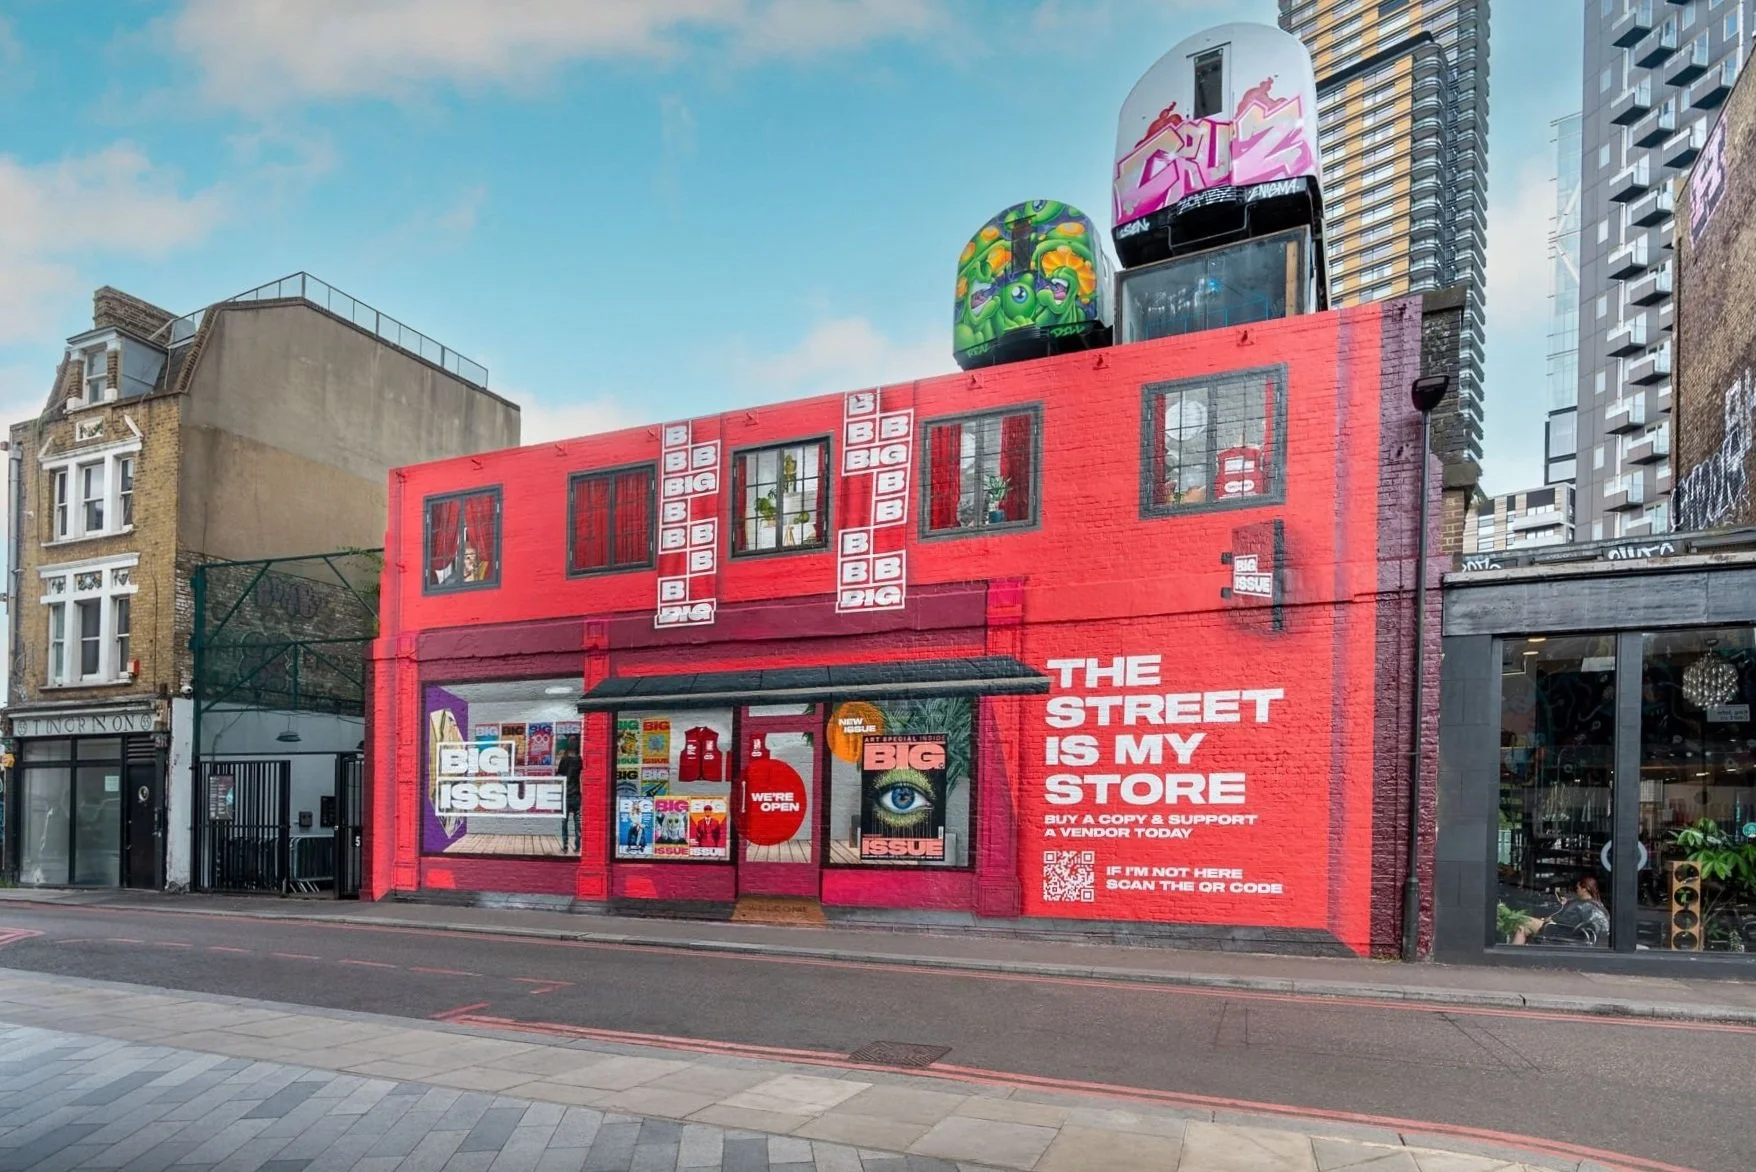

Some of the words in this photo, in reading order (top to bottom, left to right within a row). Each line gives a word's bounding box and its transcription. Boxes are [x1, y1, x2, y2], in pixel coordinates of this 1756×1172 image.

[665, 425, 688, 448] B
[846, 421, 874, 444] B
[881, 415, 909, 439] B
[665, 451, 687, 474] B
[693, 445, 717, 468] B
[847, 443, 908, 470] BIG
[664, 472, 717, 498] BIG
[878, 470, 905, 495] B
[664, 501, 687, 524] B
[876, 498, 902, 523] B
[662, 528, 686, 551] B
[691, 523, 714, 545] B
[843, 532, 869, 555] B
[691, 549, 714, 572] B
[843, 560, 868, 584] B
[874, 556, 901, 581] B
[1235, 559, 1256, 572] BIG
[661, 580, 685, 602] B
[1235, 576, 1270, 593] ISSUE
[841, 585, 902, 608] BIG
[1046, 654, 1162, 689] THE
[1045, 688, 1285, 729] STREET
[476, 726, 498, 736] BIG
[502, 726, 524, 735] BIG
[643, 721, 670, 731] BIG
[838, 718, 863, 727] NEW
[843, 724, 877, 733] ISSUE
[441, 746, 509, 774] BIG
[863, 743, 945, 771] BIG
[1045, 734, 1100, 767] IS
[1115, 732, 1208, 766] MY
[440, 783, 562, 810] ISSUE
[751, 792, 795, 802] WE'RE
[1044, 772, 1246, 806] STORE
[655, 799, 689, 812] BIG
[760, 802, 800, 812] OPEN
[1044, 814, 1079, 826] BUY
[1082, 814, 1095, 825] A
[1098, 814, 1147, 825] COPY
[1151, 814, 1164, 825] &
[1168, 814, 1259, 825] SUPPORT
[1044, 828, 1057, 838] A
[1060, 828, 1130, 838] VENDOR
[1134, 828, 1193, 839] TODAY
[655, 847, 689, 855] ISSUE
[861, 839, 944, 856] ISSUE
[1106, 866, 1123, 877] IF
[1125, 866, 1150, 877] I'M
[1152, 867, 1190, 878] NOT
[1193, 868, 1243, 879] HERE
[1106, 879, 1157, 890] SCAN
[1160, 880, 1195, 892] THE
[1199, 881, 1225, 893] QR
[1229, 882, 1283, 894] CODE
